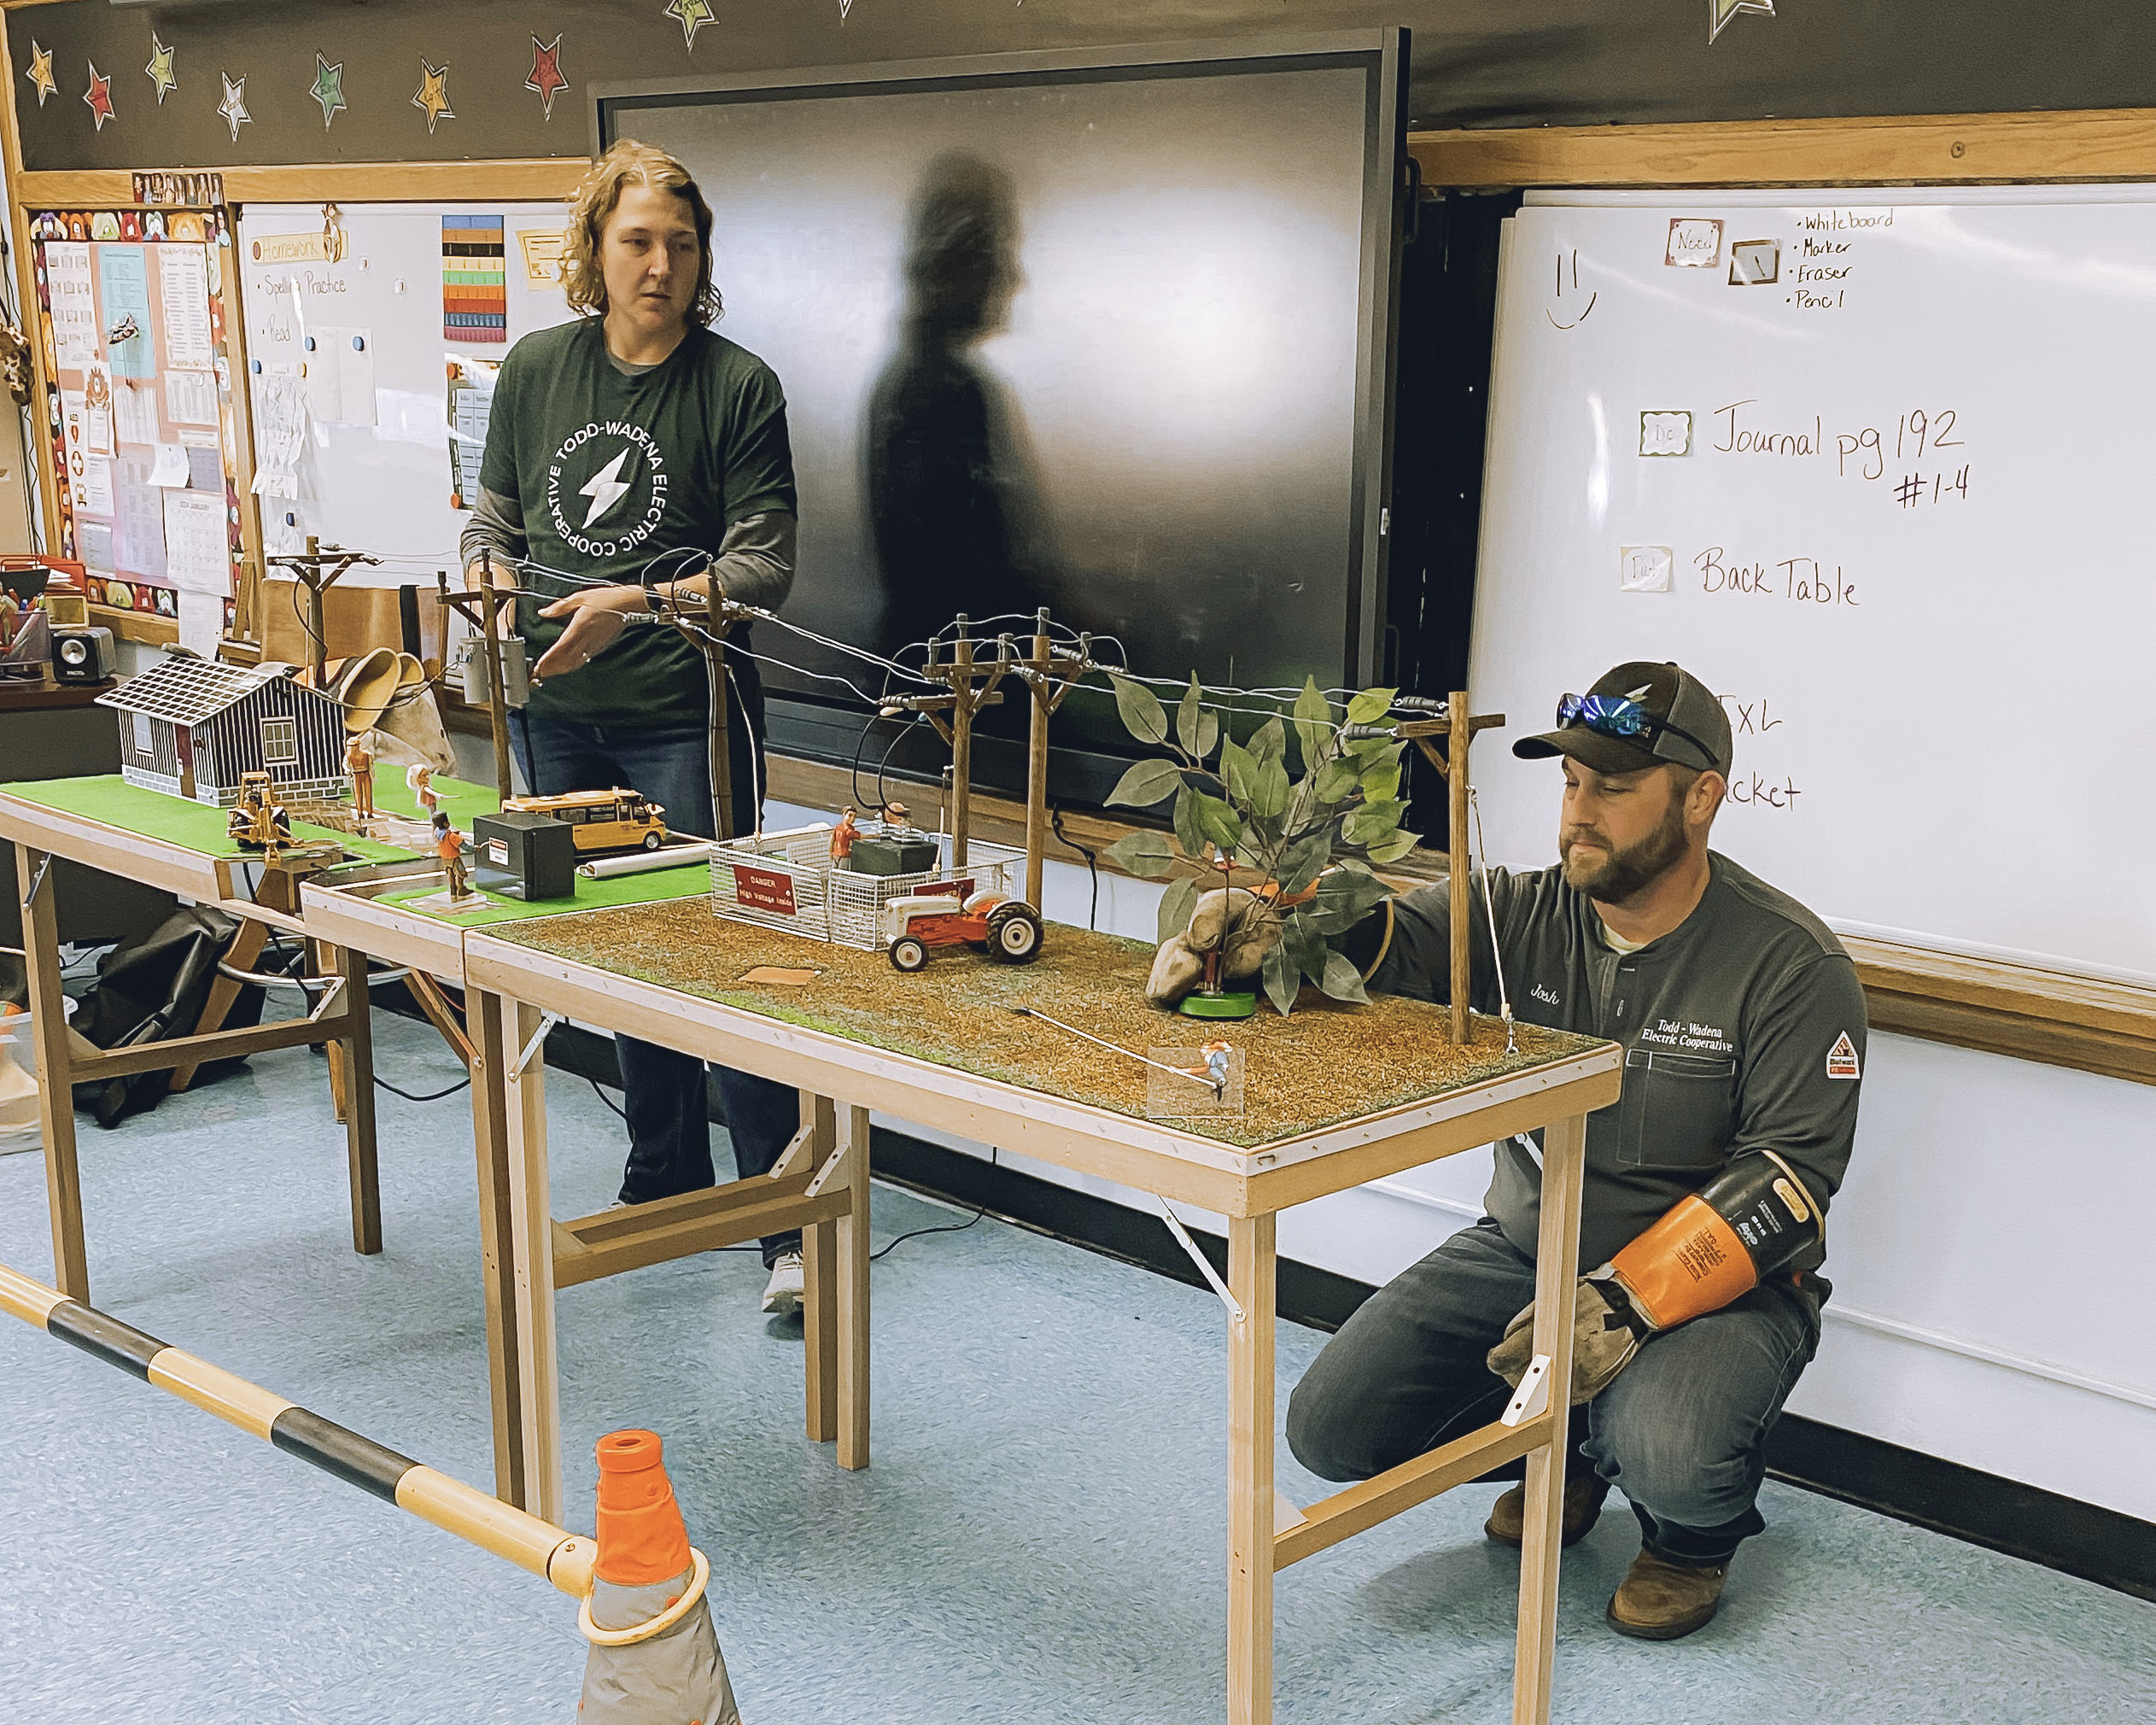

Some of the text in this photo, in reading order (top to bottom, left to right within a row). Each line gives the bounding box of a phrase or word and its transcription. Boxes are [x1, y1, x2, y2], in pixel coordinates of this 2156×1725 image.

[1805, 208, 1894, 231] Whiteboard
[262, 237, 318, 260] Homework
[1803, 237, 1852, 258] Marker
[303, 270, 347, 295] Practice
[1797, 264, 1854, 284] Eraser
[1795, 289, 1845, 309] Pencil
[267, 313, 292, 342] Read
[1714, 400, 1966, 480] Journal pg 192
[547, 420, 669, 557] TODD-WADENA ELECTRIC COOPERATIVE
[1693, 547, 1861, 606] Back Table
[1530, 983, 1561, 1005] Josh
[1641, 1028, 1733, 1052] Electric Cooperative
[1657, 1019, 1681, 1034] Todd
[1688, 1021, 1723, 1038] Wadena
